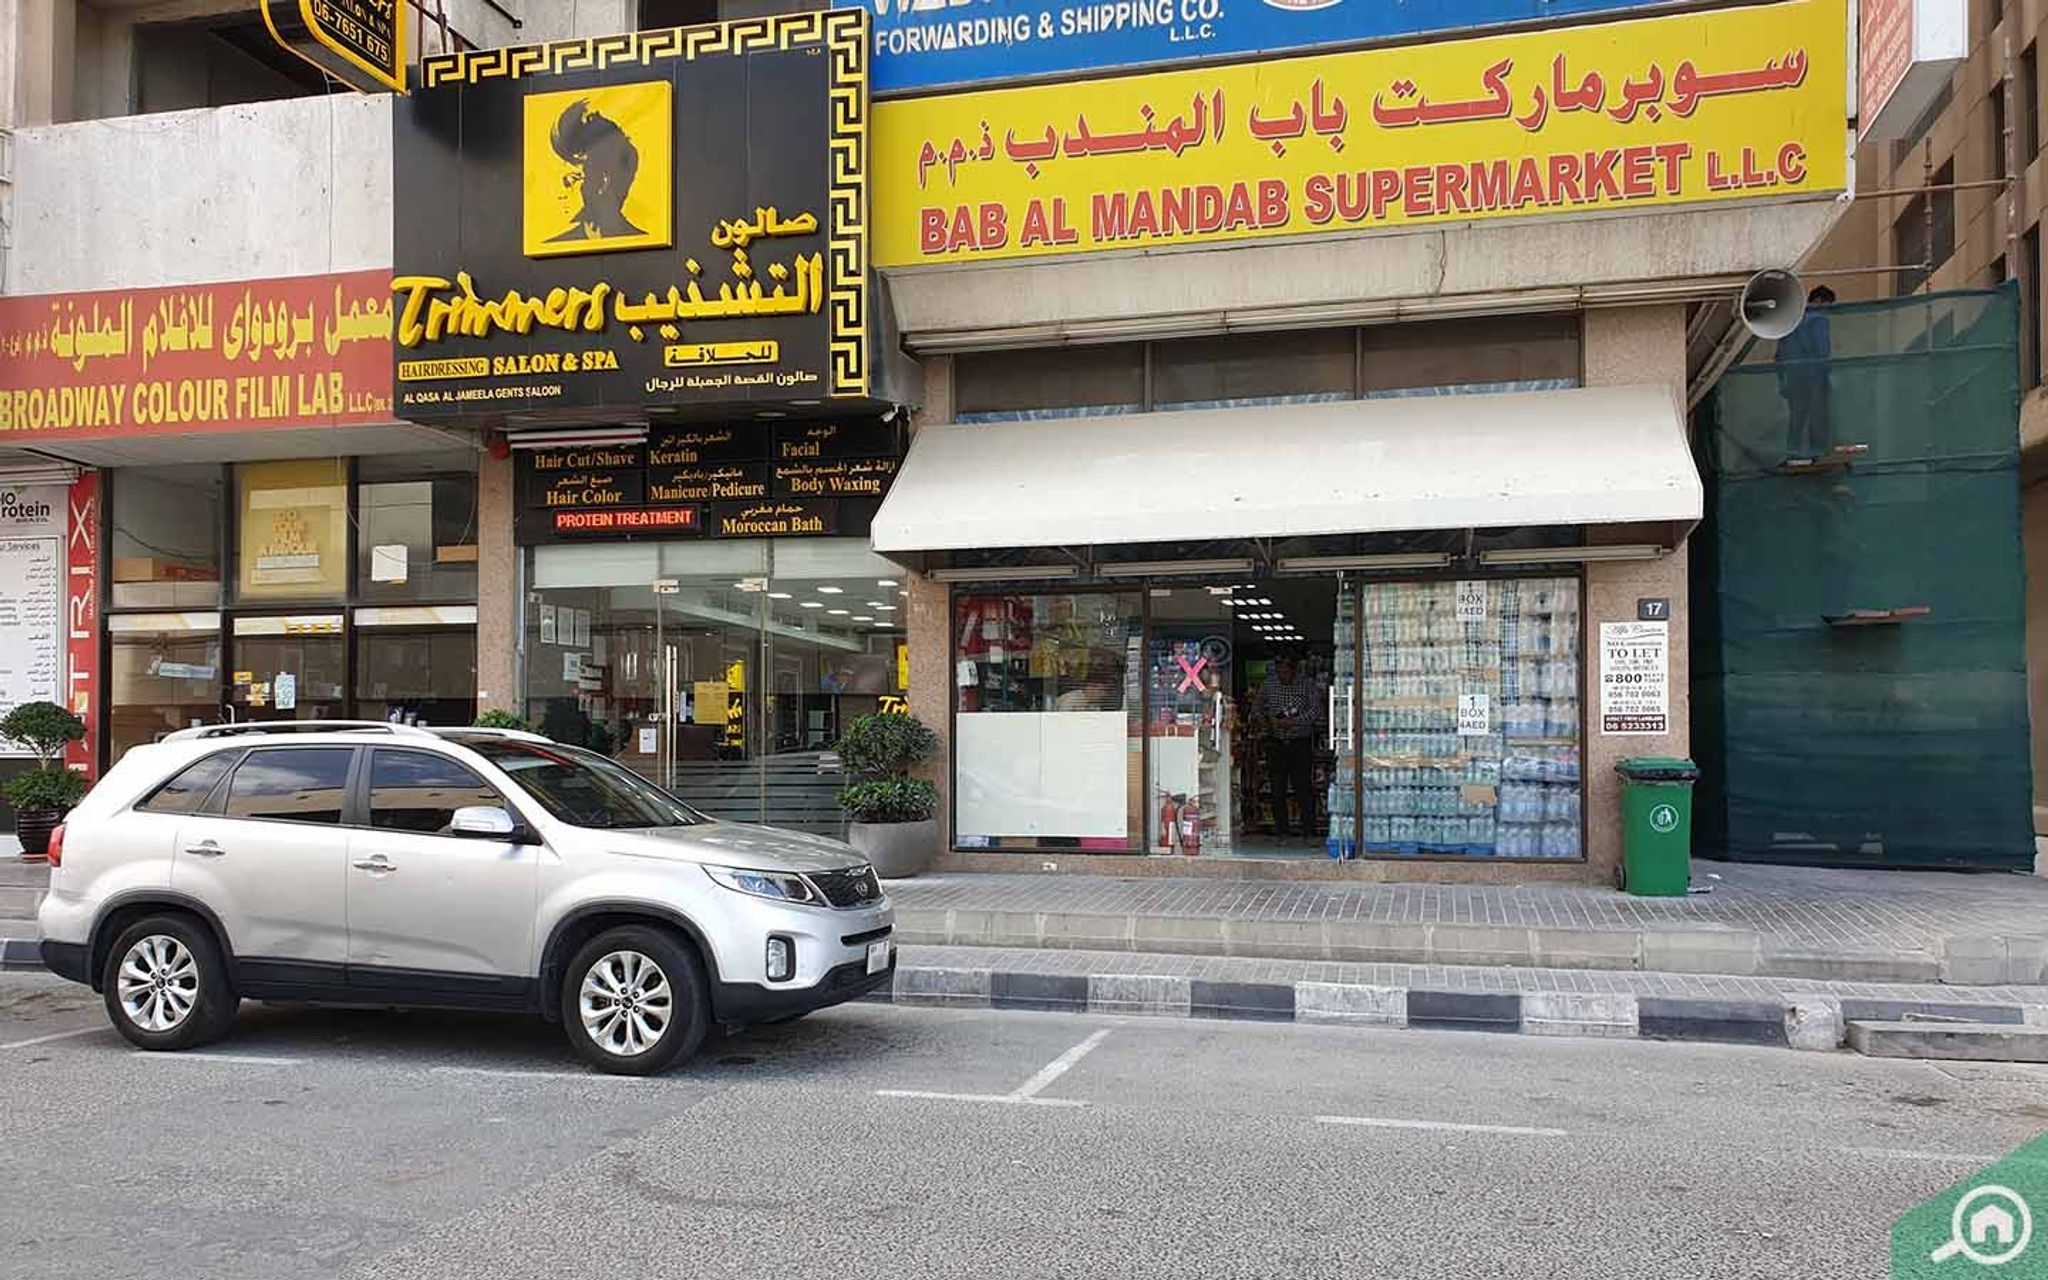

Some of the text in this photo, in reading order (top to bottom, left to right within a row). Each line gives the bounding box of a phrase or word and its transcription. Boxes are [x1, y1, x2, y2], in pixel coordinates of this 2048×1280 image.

[875, 14, 1031, 55] FORWARDING
[1038, 12, 1054, 38] &
[1060, 0, 1174, 36] SHIPPING
[366, 34, 388, 61] 675
[1371, 46, 1808, 132] سوبرماركت
[1248, 78, 1348, 158] باب
[1004, 88, 1226, 179] المندب
[920, 201, 1007, 255] BAB
[1020, 197, 1078, 246] AL
[1091, 179, 1289, 241] MANDAB
[1303, 142, 1692, 223] SUPERMARKET
[711, 206, 818, 248] صالون
[389, 271, 610, 347] Trimmers
[324, 284, 394, 356] معمل
[401, 350, 620, 379] HAIRDRESSING SALON & SPA
[776, 370, 818, 387] صالون
[0, 384, 126, 431] BROADWAY
[132, 377, 229, 426] COLOUR
[235, 375, 291, 421] FILM
[297, 371, 345, 416] LAB
[649, 448, 698, 465] Keratin
[781, 441, 820, 457] Facial
[535, 451, 635, 469] Hair Cut/Shave
[790, 476, 881, 495] Body Waxing
[546, 489, 623, 505] Hair Color
[557, 510, 693, 528] PROTEIN TREATMENT
[722, 516, 823, 534] Moroccan Bath
[1646, 602, 1663, 616] 17
[1606, 648, 1662, 659] TO LET
[1615, 672, 1643, 684] 800
[1460, 708, 1486, 718] BOX
